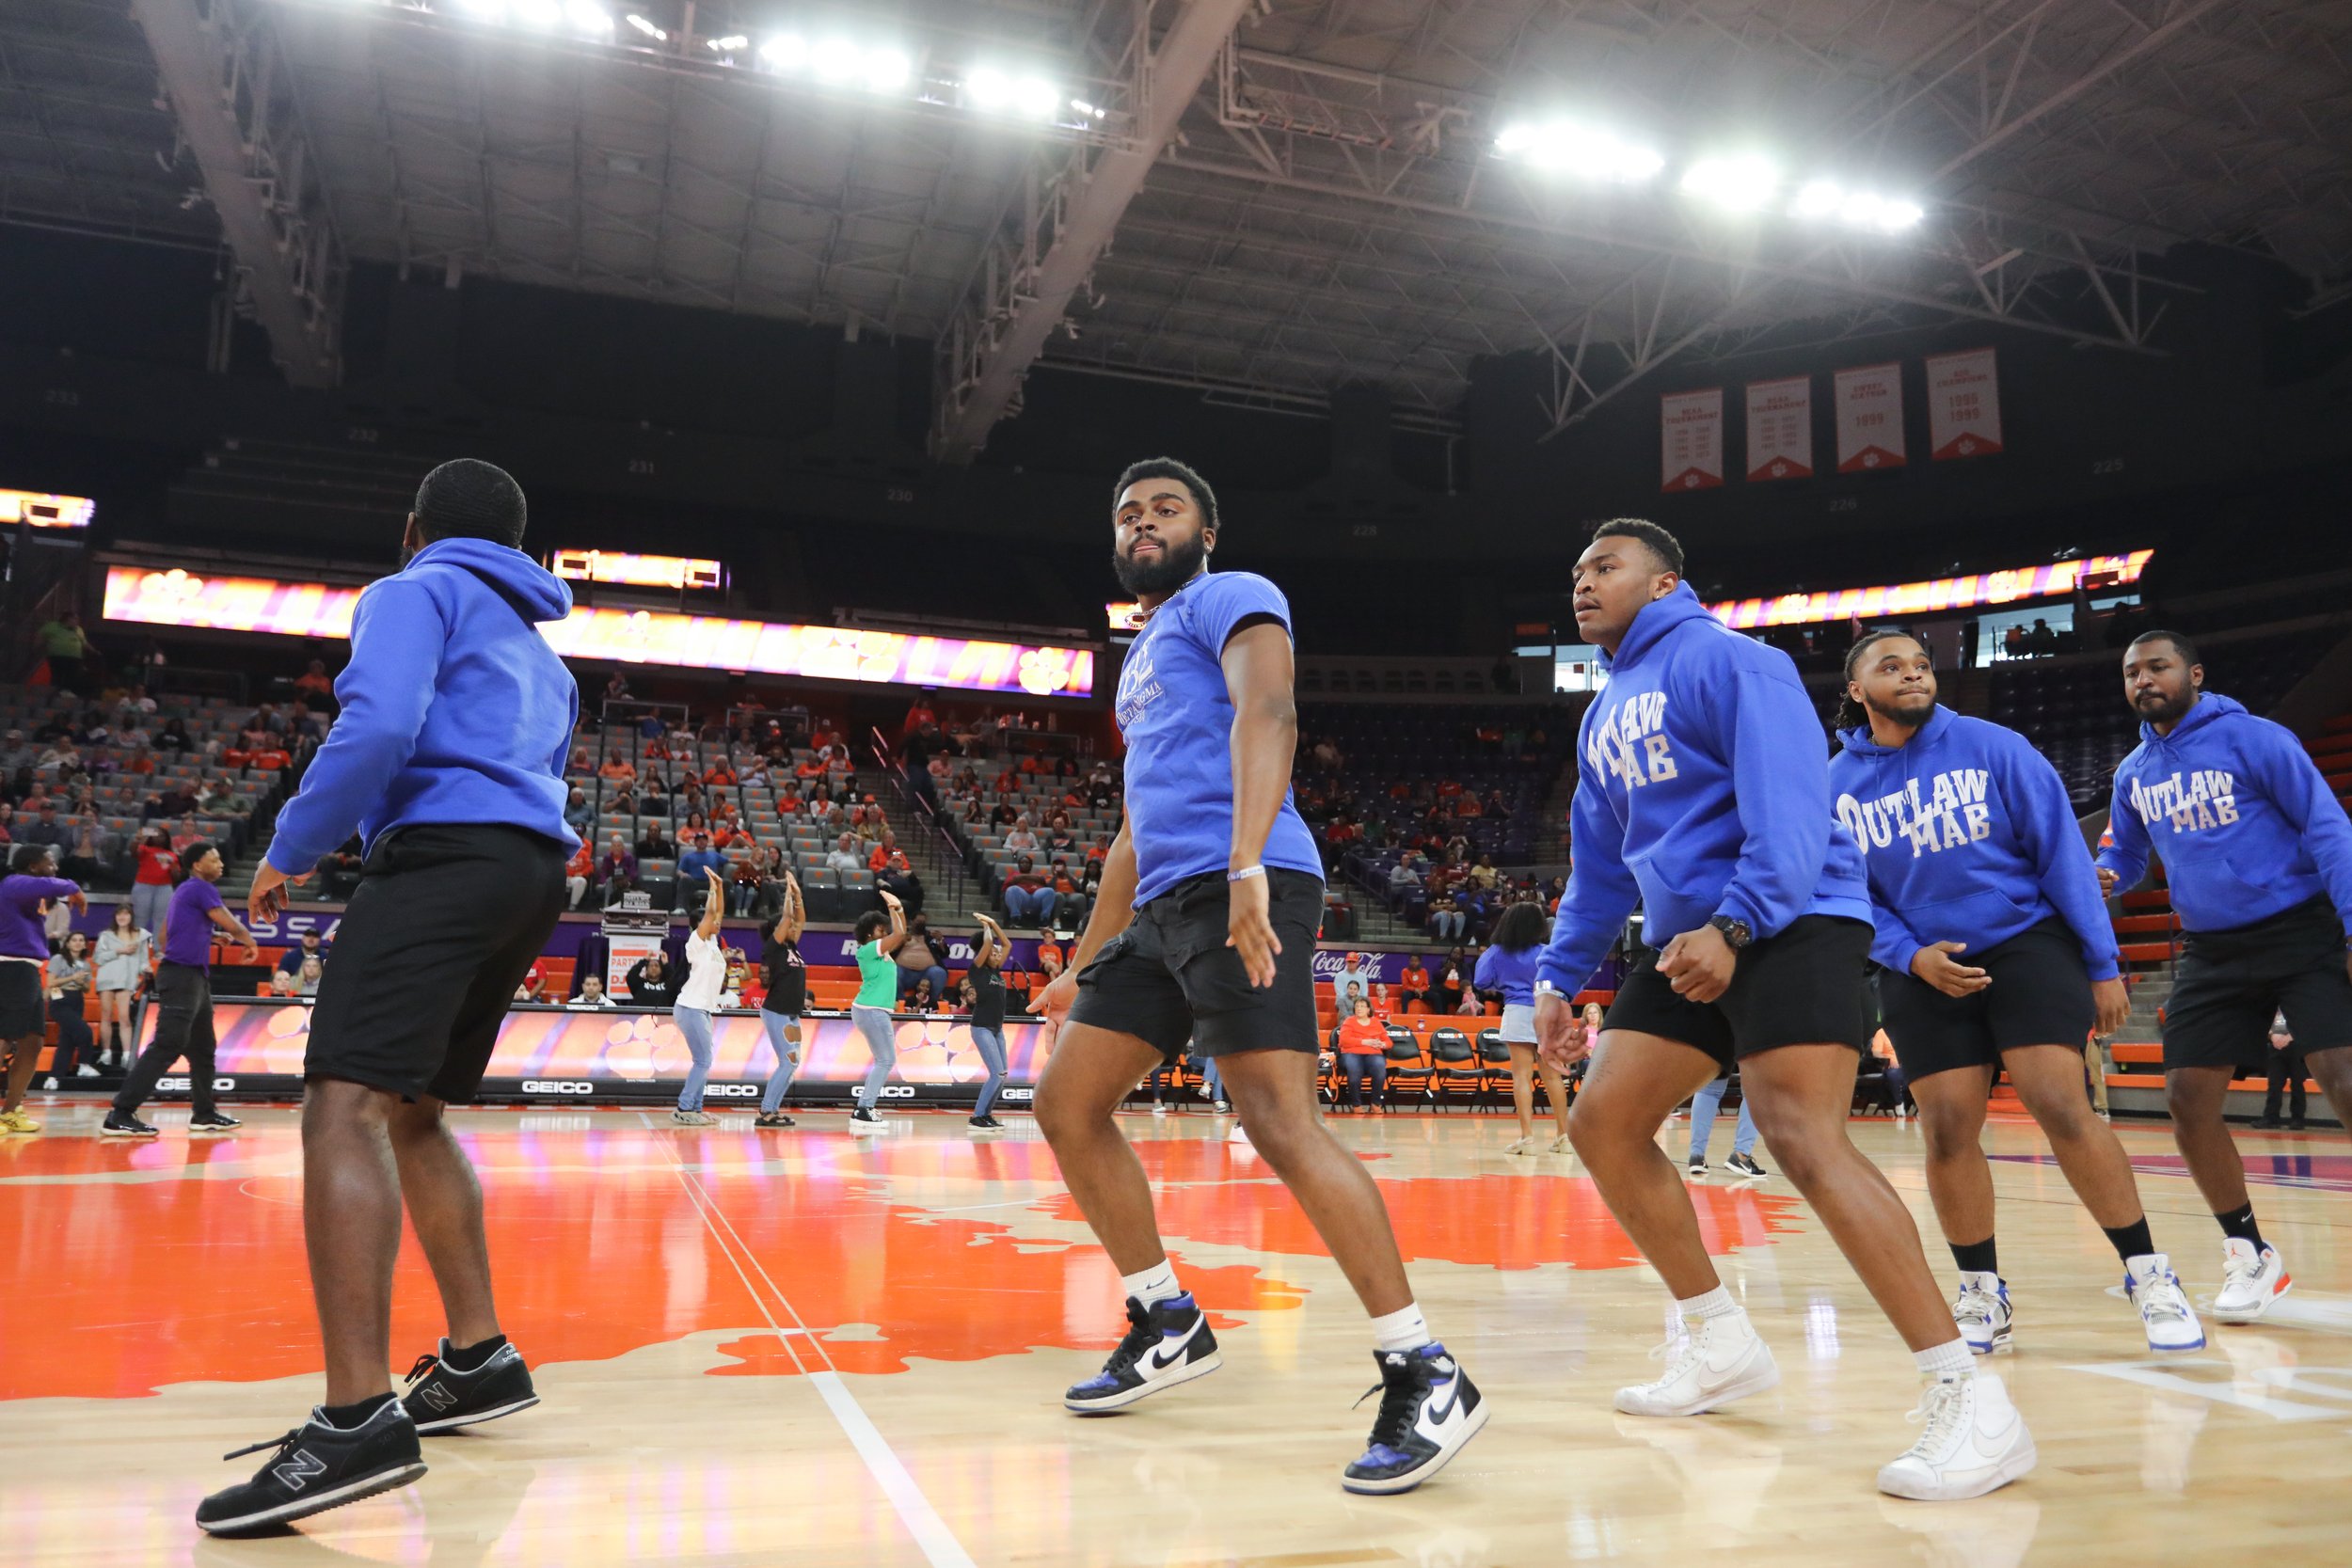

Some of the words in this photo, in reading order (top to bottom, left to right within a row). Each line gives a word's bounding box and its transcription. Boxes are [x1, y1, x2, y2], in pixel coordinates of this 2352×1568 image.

[2093, 458, 2123, 474] 225
[887, 488, 914, 502] 230
[1829, 497, 1857, 512] 226
[2131, 770, 2233, 825] OUTLAW
[1836, 768, 1989, 856] OUTLAW
[2171, 795, 2240, 833] MAB
[1907, 802, 1991, 858] MAB
[155, 1078, 235, 1091] GEO
[522, 1081, 594, 1095] GEICO
[703, 1085, 758, 1097] EICO
[850, 1085, 915, 1098] GICO
[1002, 1088, 1034, 1100] GEI
[272, 1448, 327, 1492] N
